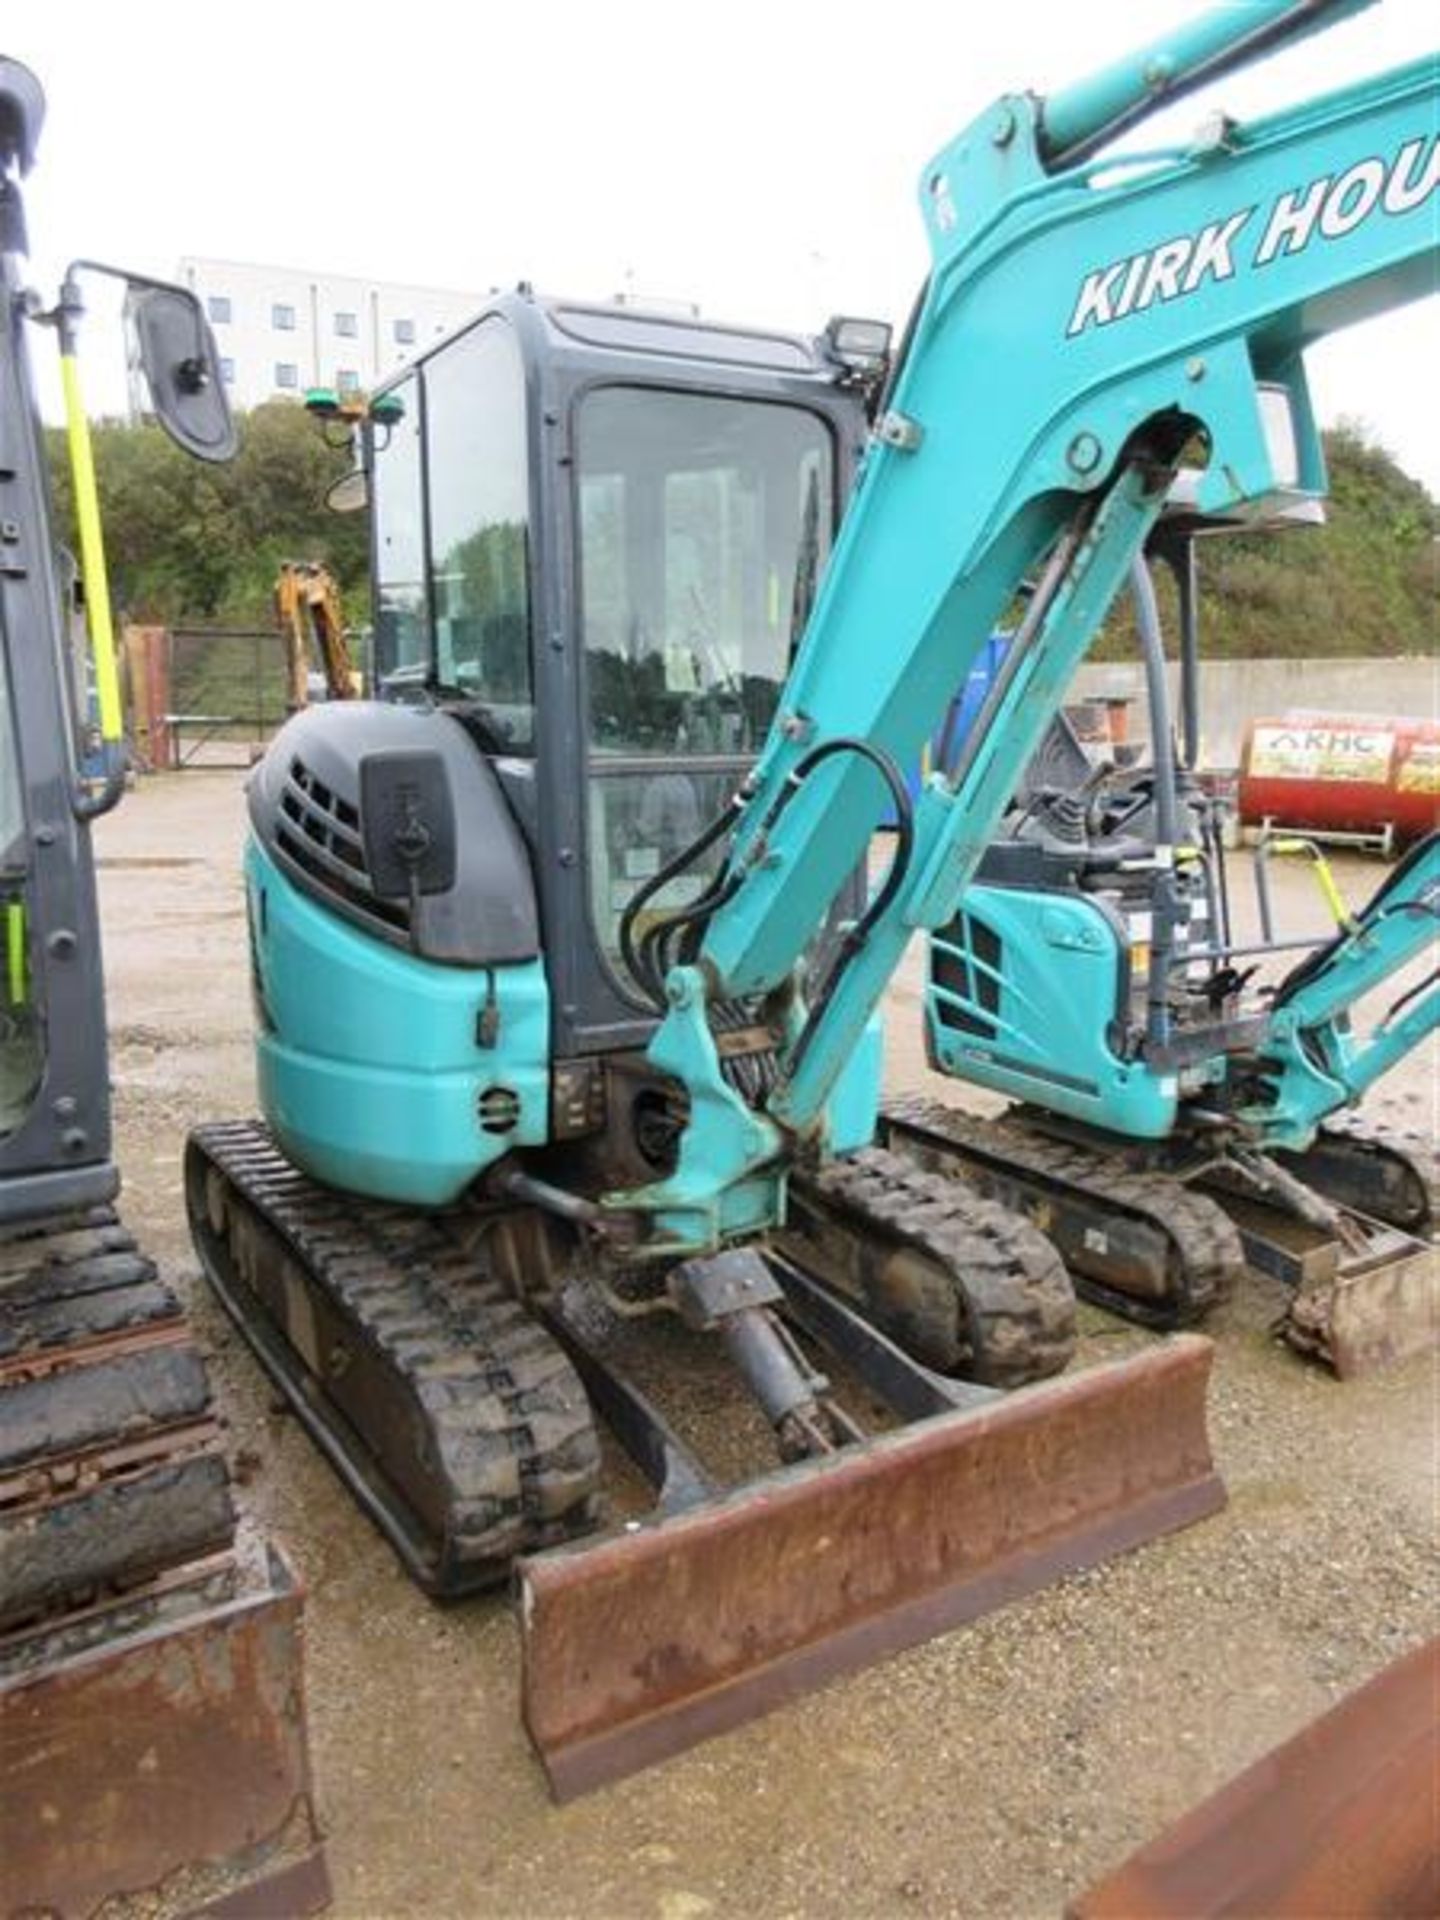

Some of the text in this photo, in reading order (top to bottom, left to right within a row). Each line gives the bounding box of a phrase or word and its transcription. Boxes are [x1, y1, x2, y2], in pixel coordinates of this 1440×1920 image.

[1065, 132, 1440, 339] KIRK HOU
[1304, 731, 1377, 752] KHC
